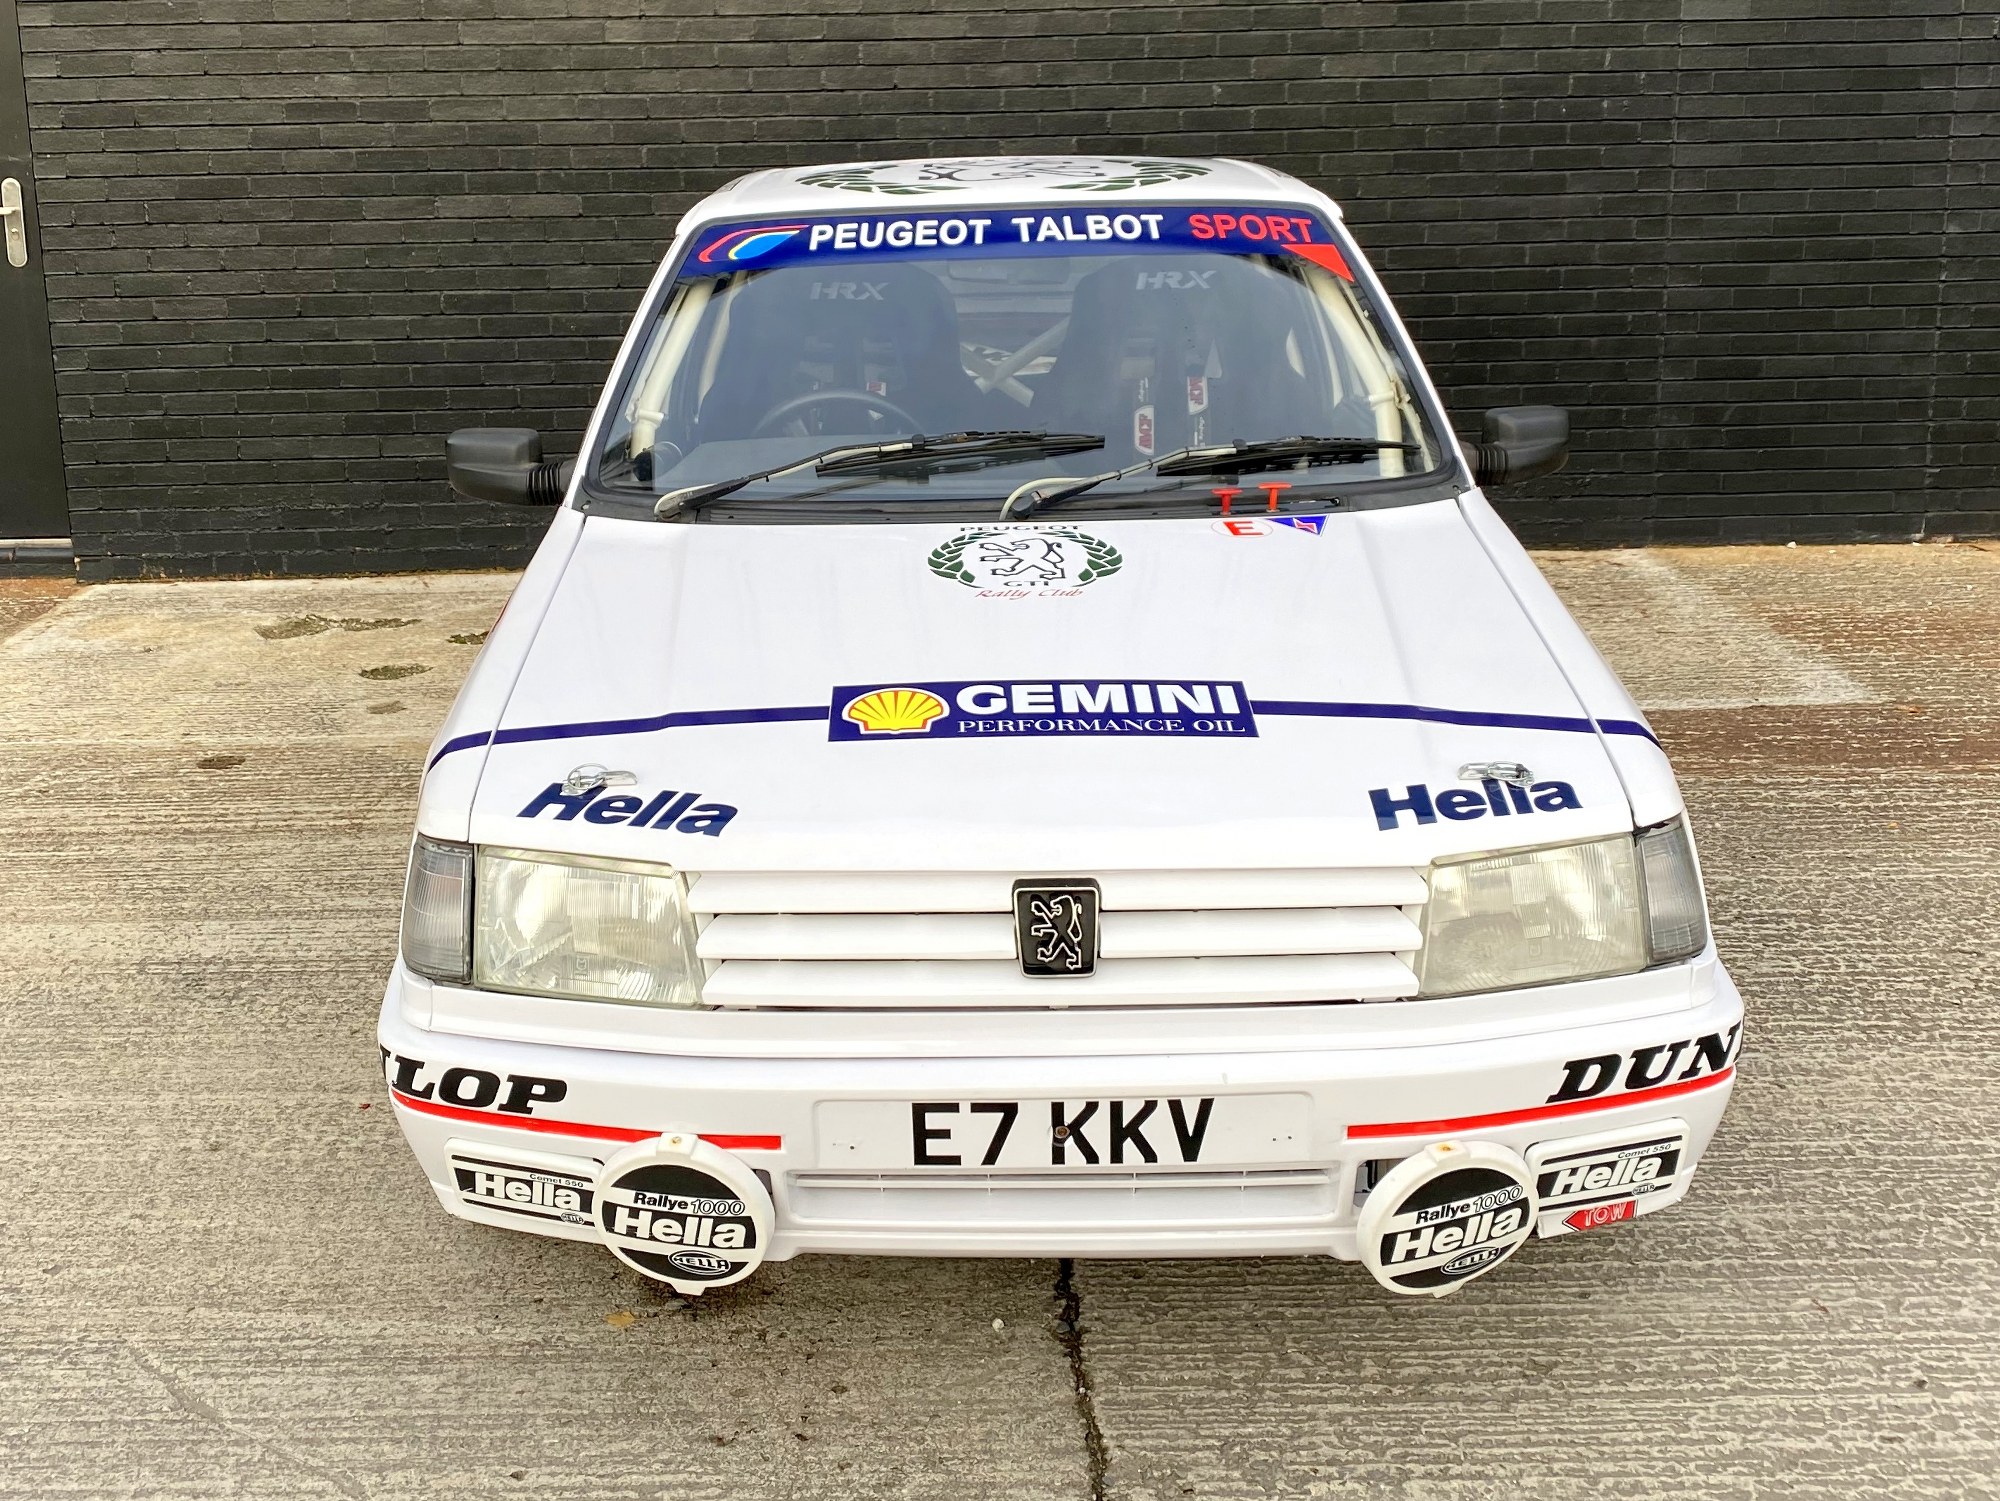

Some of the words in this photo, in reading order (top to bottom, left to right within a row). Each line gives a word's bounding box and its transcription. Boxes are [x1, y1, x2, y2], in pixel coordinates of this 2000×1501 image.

[808, 219, 992, 251] PEUGEOT
[1011, 214, 1164, 242] TALBOT
[1188, 214, 1312, 243] SPORT
[810, 281, 889, 300] HRX
[1136, 270, 1217, 290] HRX
[960, 524, 1083, 532] PEUGEOT
[1223, 521, 1264, 536] E
[974, 588, 1032, 600] Rally
[1038, 588, 1084, 598] Club
[956, 684, 1241, 715] GEMINI
[957, 719, 1185, 733] PERFORMANCE
[1193, 719, 1246, 733] OIL
[516, 782, 738, 837] Hella
[1368, 776, 1584, 831] Hella
[1545, 1019, 1743, 1104] DUN
[912, 1102, 1019, 1166] E7
[1051, 1098, 1215, 1165] KKV
[1617, 1149, 1651, 1159] Comet
[1652, 1143, 1672, 1153] 550
[475, 1171, 581, 1211] Hella
[529, 1173, 562, 1184] Comet
[564, 1180, 584, 1188] 550
[1550, 1157, 1662, 1197] Hella
[633, 1192, 689, 1210] Rallye
[690, 1199, 746, 1216] 1000
[1416, 1202, 1471, 1225] Rallye
[1472, 1184, 1523, 1213] 1000
[1585, 1201, 1628, 1226] TOW
[613, 1206, 747, 1248] Hella
[1390, 1207, 1523, 1263] Hella
[673, 1256, 731, 1271] HELLA
